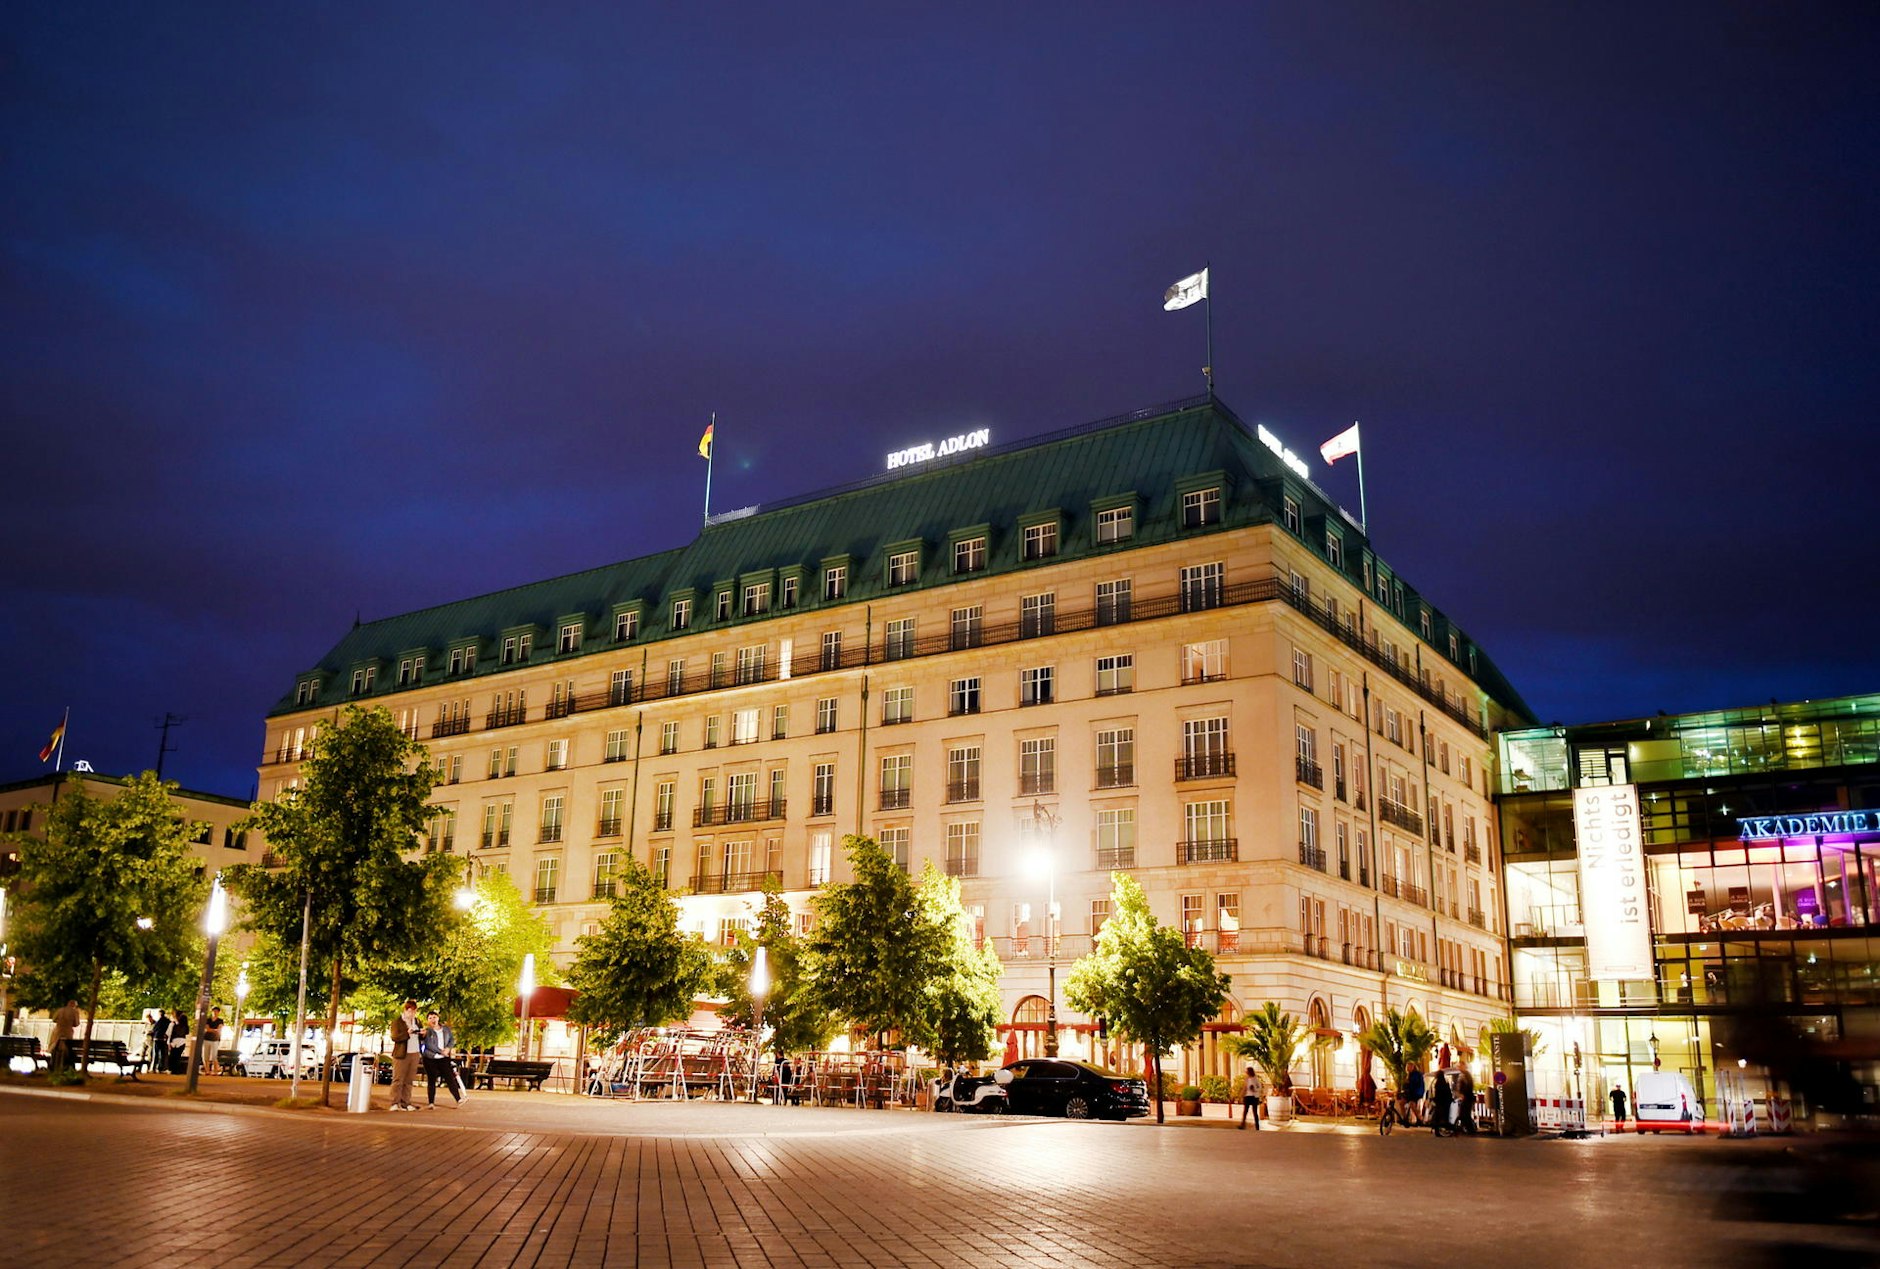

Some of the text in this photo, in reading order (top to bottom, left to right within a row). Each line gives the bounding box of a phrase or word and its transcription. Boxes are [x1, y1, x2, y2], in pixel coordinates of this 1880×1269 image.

[887, 428, 989, 469] HOTEL ADLON
[1584, 795, 1602, 868] Nichts
[1740, 813, 1868, 838] AKADEMIE
[1611, 793, 1639, 923] ist erledigt
